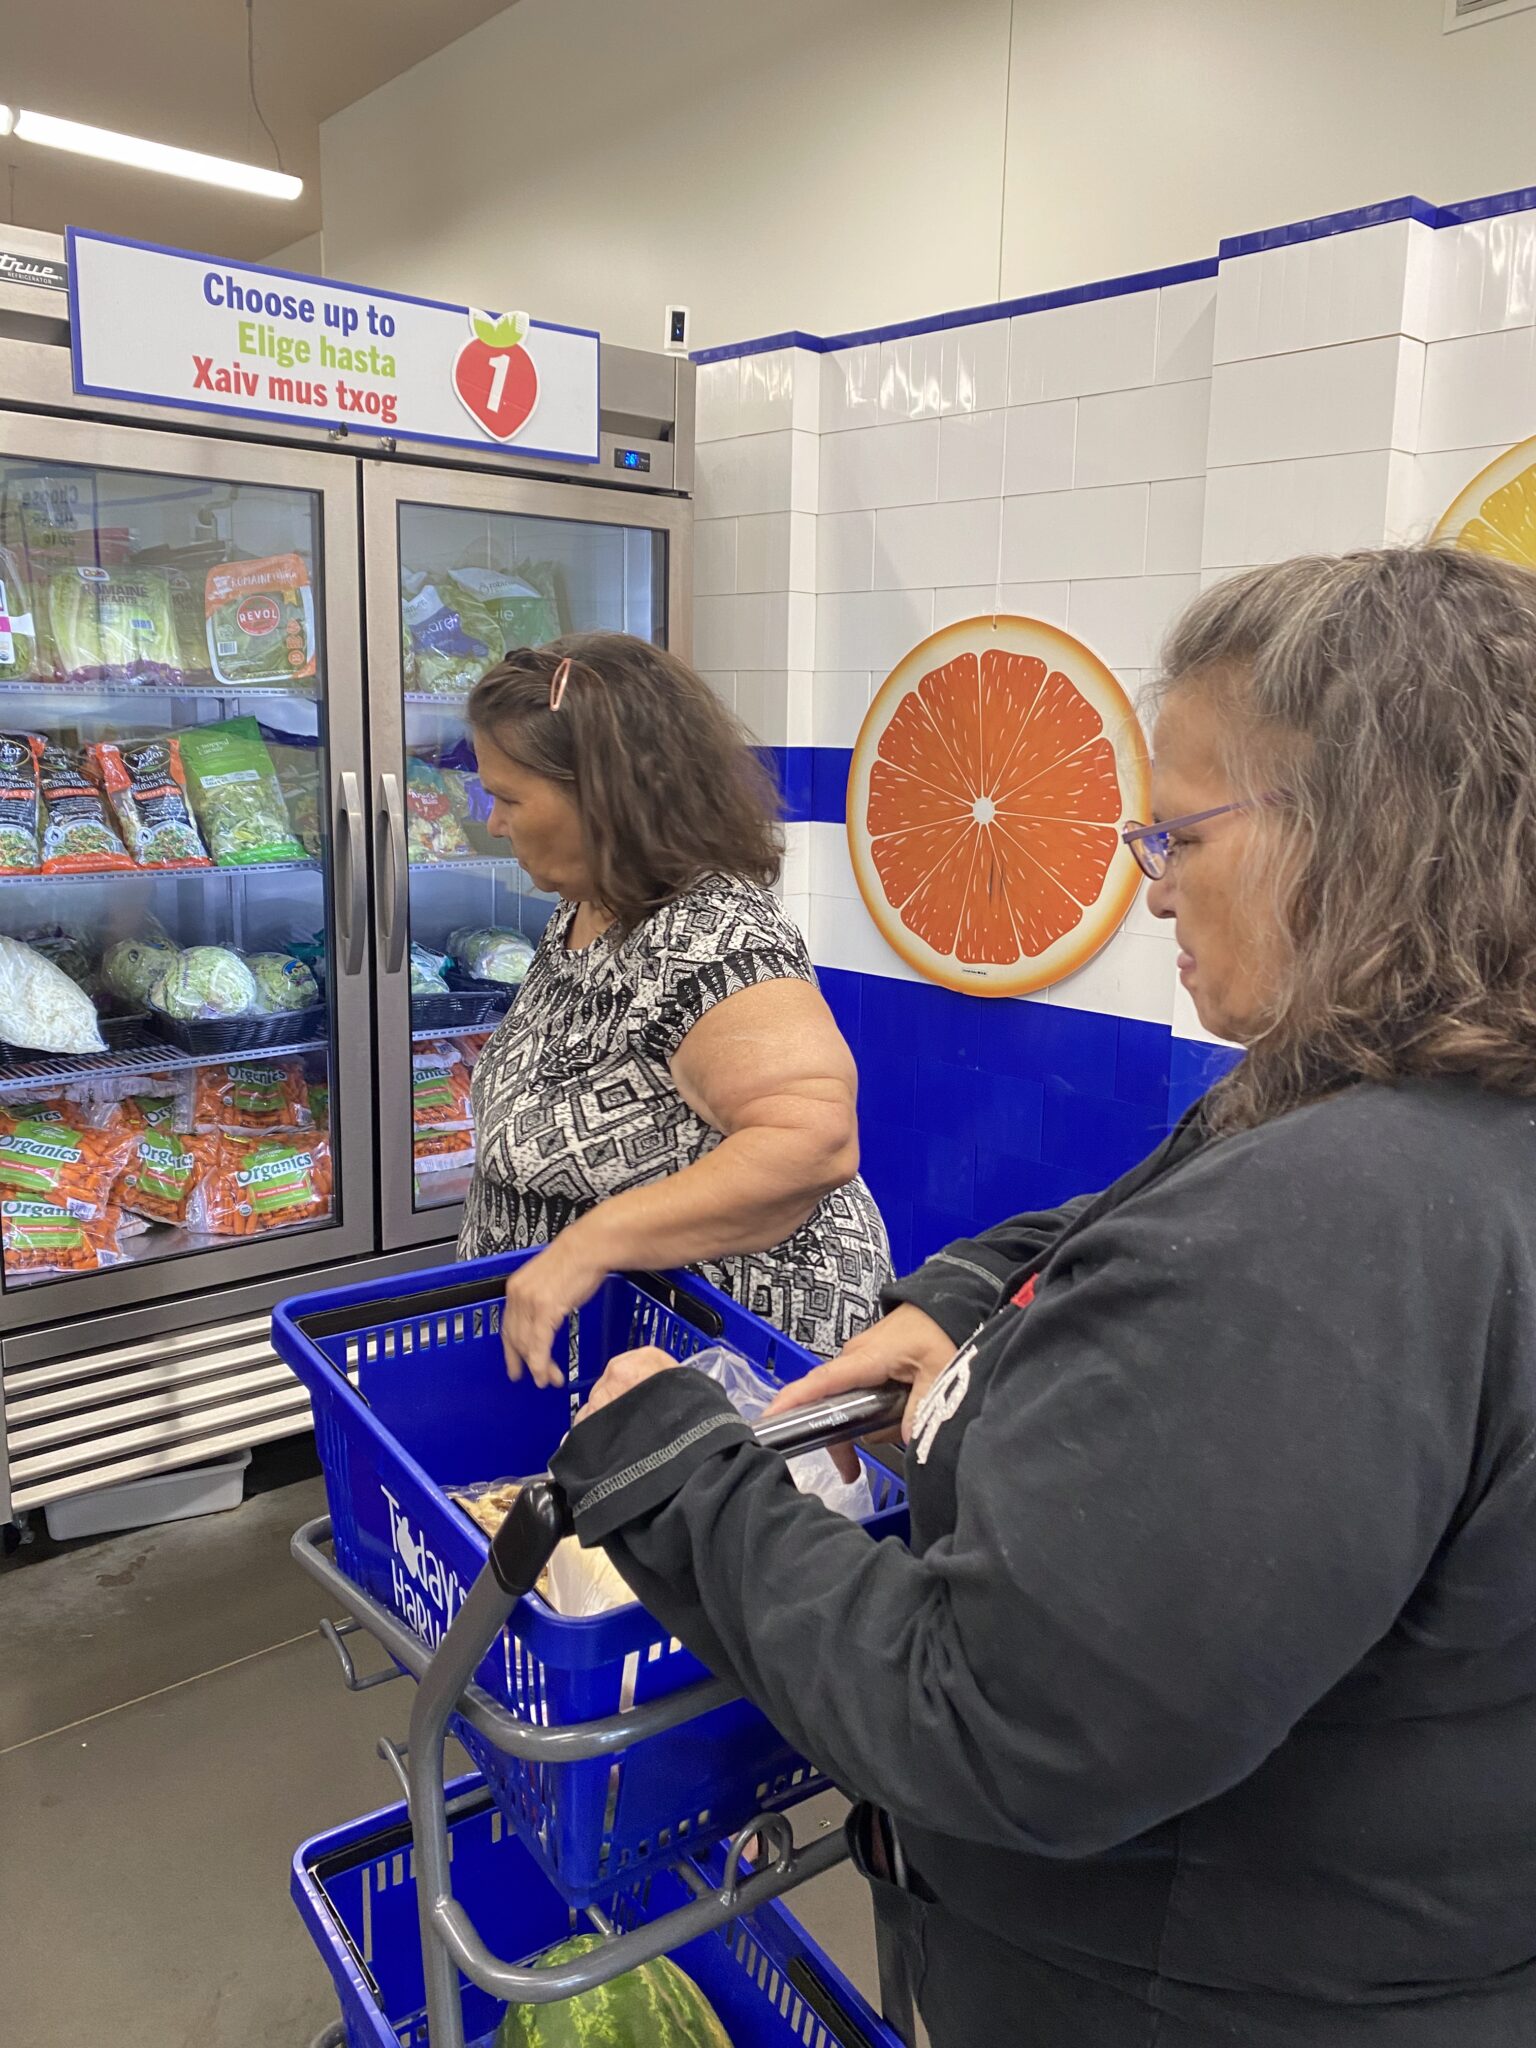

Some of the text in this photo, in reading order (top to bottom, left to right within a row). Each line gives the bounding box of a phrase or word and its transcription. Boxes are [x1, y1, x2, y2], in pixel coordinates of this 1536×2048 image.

[203, 272, 396, 338] Choose up to
[238, 320, 396, 378] Elige hasta
[192, 355, 398, 424] Xaiv mus txog
[486, 353, 511, 414] 1
[239, 609, 278, 623] REVOL
[226, 1064, 287, 1085] Organics
[0, 1134, 80, 1162] Organics
[236, 1153, 312, 1183] Organics
